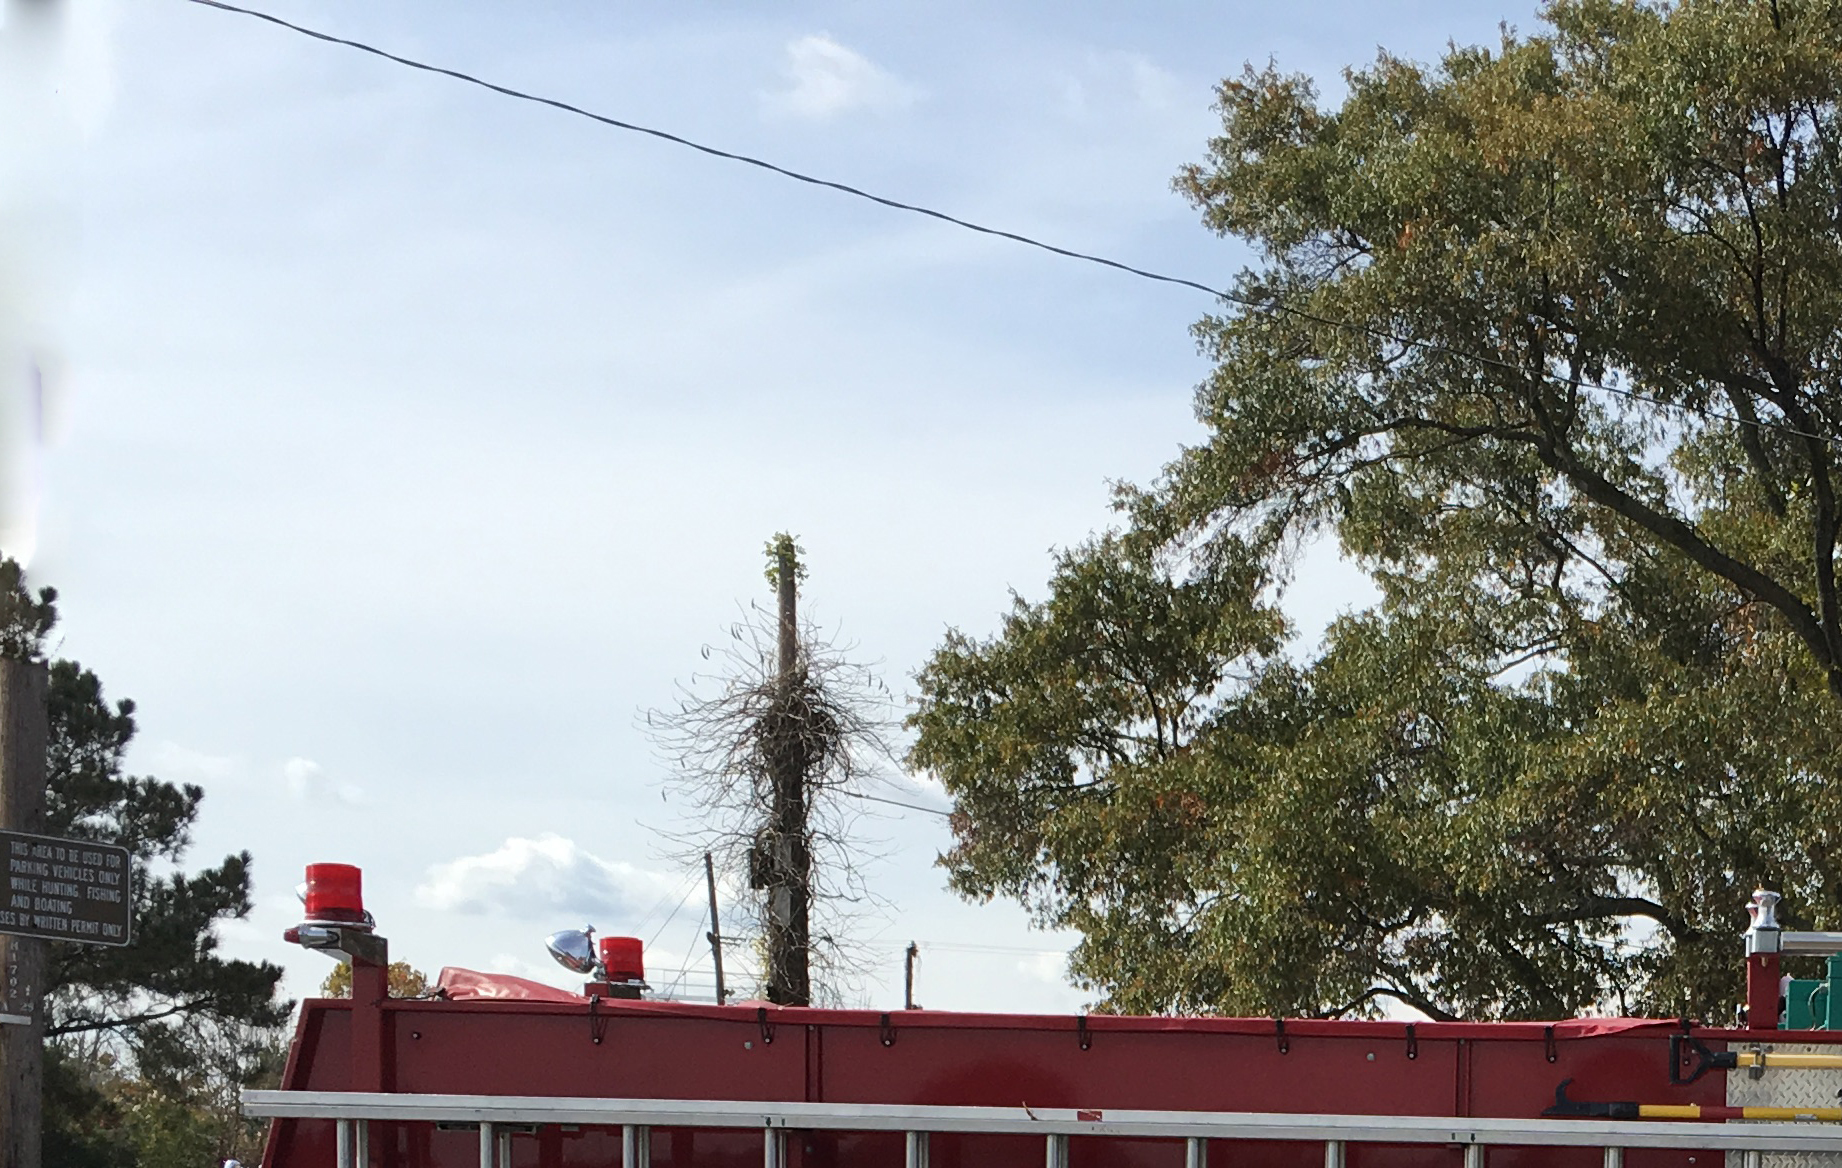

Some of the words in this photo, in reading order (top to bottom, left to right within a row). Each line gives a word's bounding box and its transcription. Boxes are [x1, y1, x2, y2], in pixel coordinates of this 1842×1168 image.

[10, 841, 28, 856] THIS
[31, 845, 52, 859] AREA
[55, 847, 65, 861] TO
[68, 849, 79, 863] BE
[82, 851, 103, 866] USED
[106, 854, 121, 868] FOR
[10, 859, 48, 877] PARKING
[52, 865, 94, 882] VEHICLES
[98, 870, 120, 885] ONLY
[10, 876, 37, 893] WHILE
[87, 886, 121, 903] FISHING
[11, 894, 30, 909] AND
[34, 897, 72, 915] BOATING
[19, 913, 30, 926] BY
[33, 914, 67, 931] WRITTEN
[71, 919, 99, 934] PERMIT
[102, 922, 123, 937] ONLY
